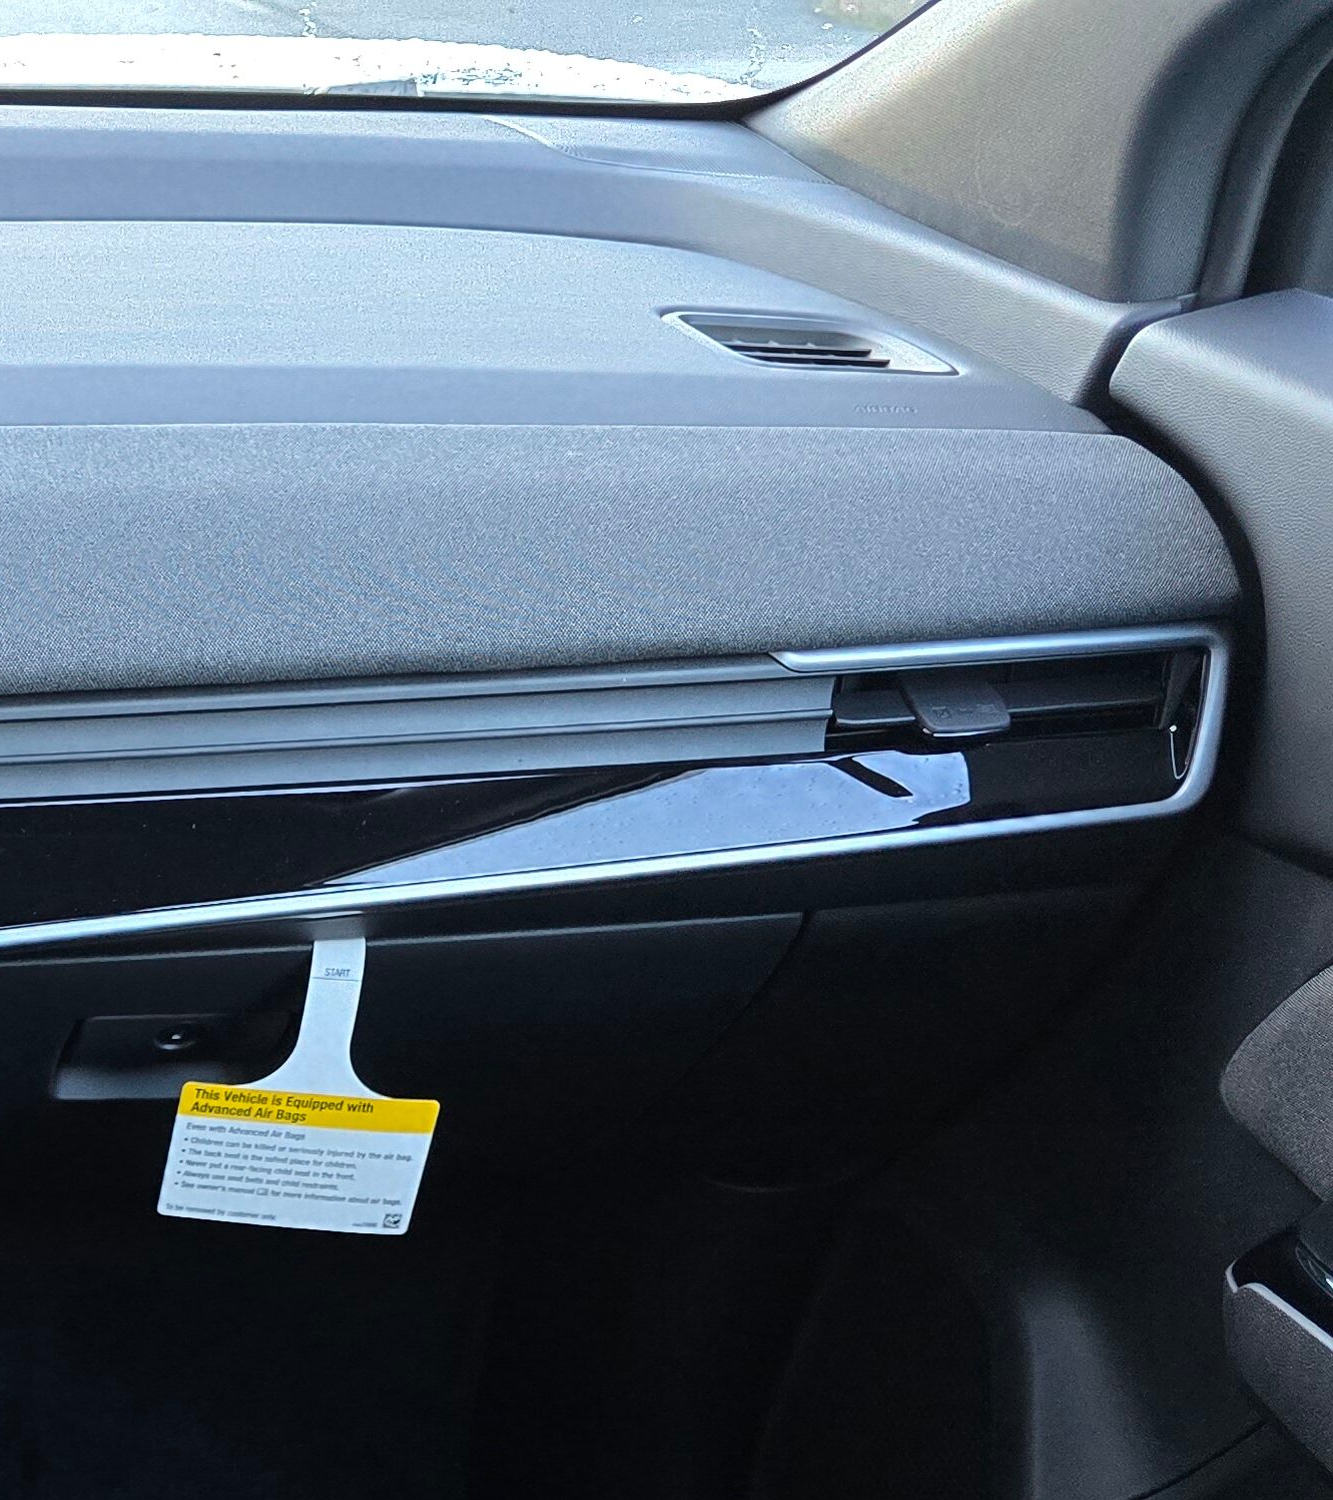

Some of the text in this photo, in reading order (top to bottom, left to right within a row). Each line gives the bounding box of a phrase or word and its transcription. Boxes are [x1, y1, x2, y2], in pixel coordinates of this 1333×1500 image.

[325, 967, 351, 977] START
[194, 1088, 374, 1112] This Vehicle is Equipped with
[190, 1101, 307, 1123] Advanced Air Bags
[186, 1122, 206, 1130] Even
[227, 1127, 269, 1136] Advanced
[190, 1137, 223, 1145] Children
